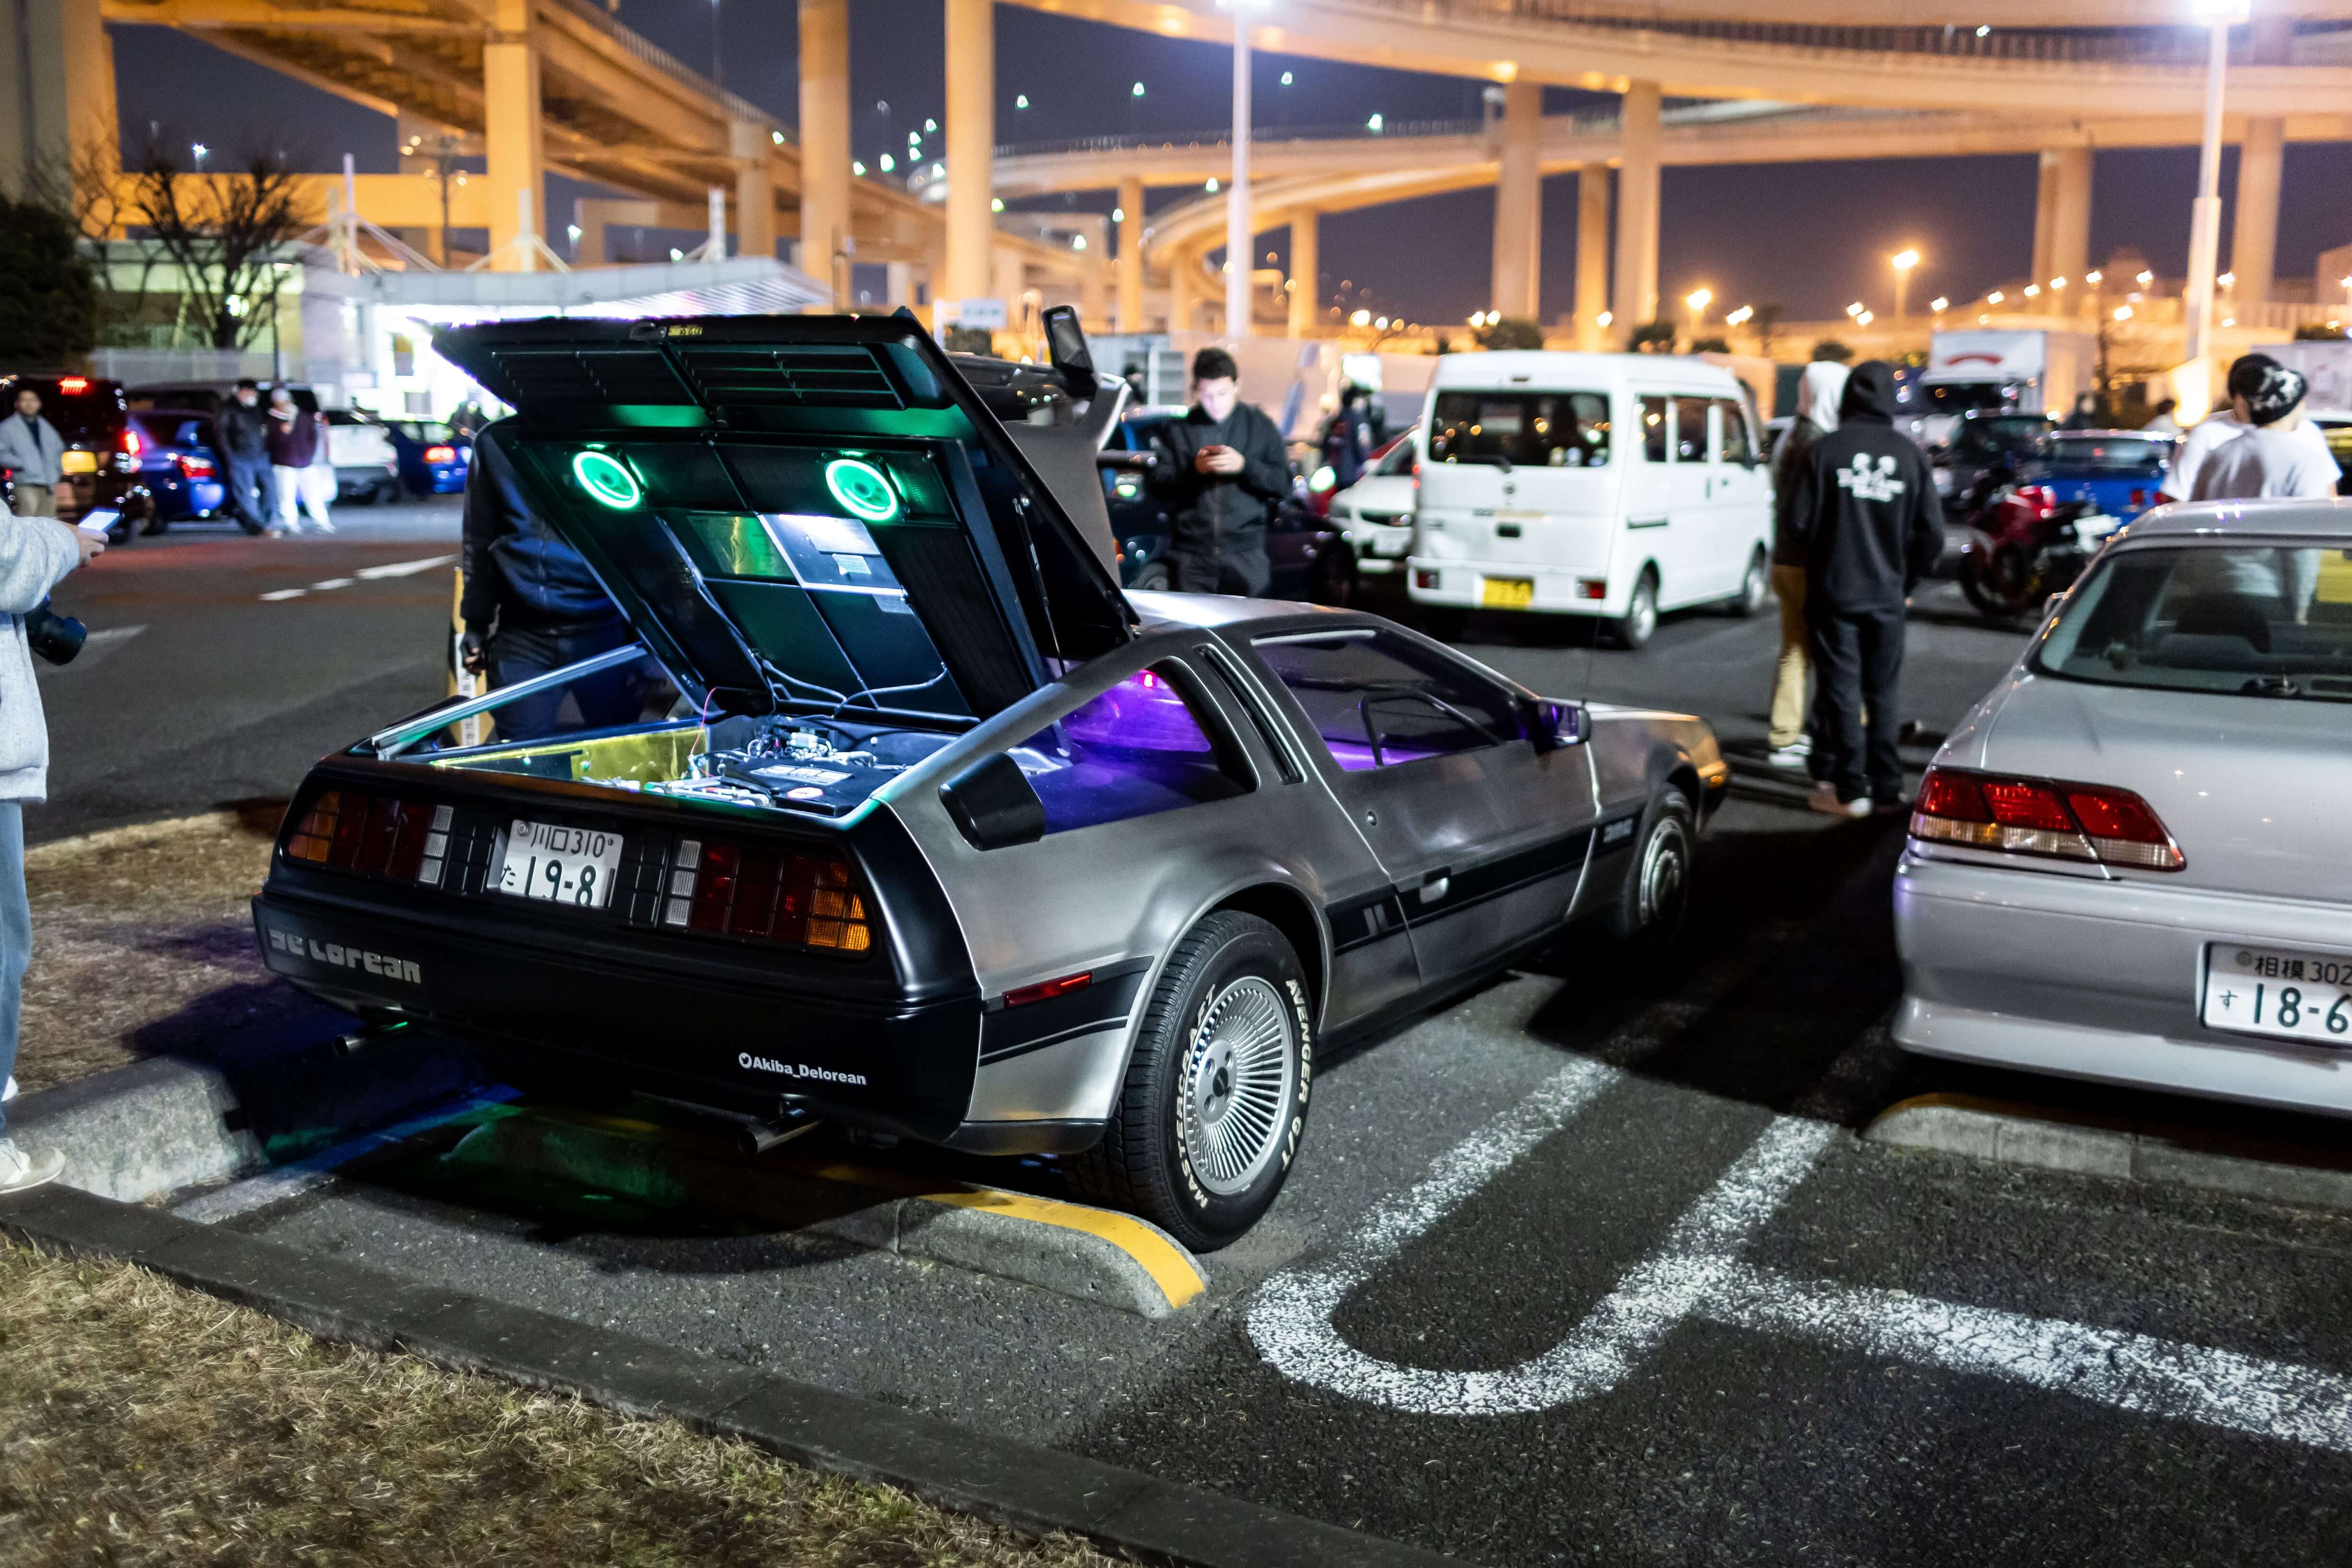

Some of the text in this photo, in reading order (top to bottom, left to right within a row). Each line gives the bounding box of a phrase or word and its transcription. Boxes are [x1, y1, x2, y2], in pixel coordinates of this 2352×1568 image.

[531, 824, 606, 858] 川口 310
[500, 864, 516, 886] た
[2308, 961, 2352, 987] 302
[2219, 989, 2239, 1010] す
[1285, 978, 1312, 1103] AVENGER
[753, 1056, 867, 1085] Akiba_Delorean
